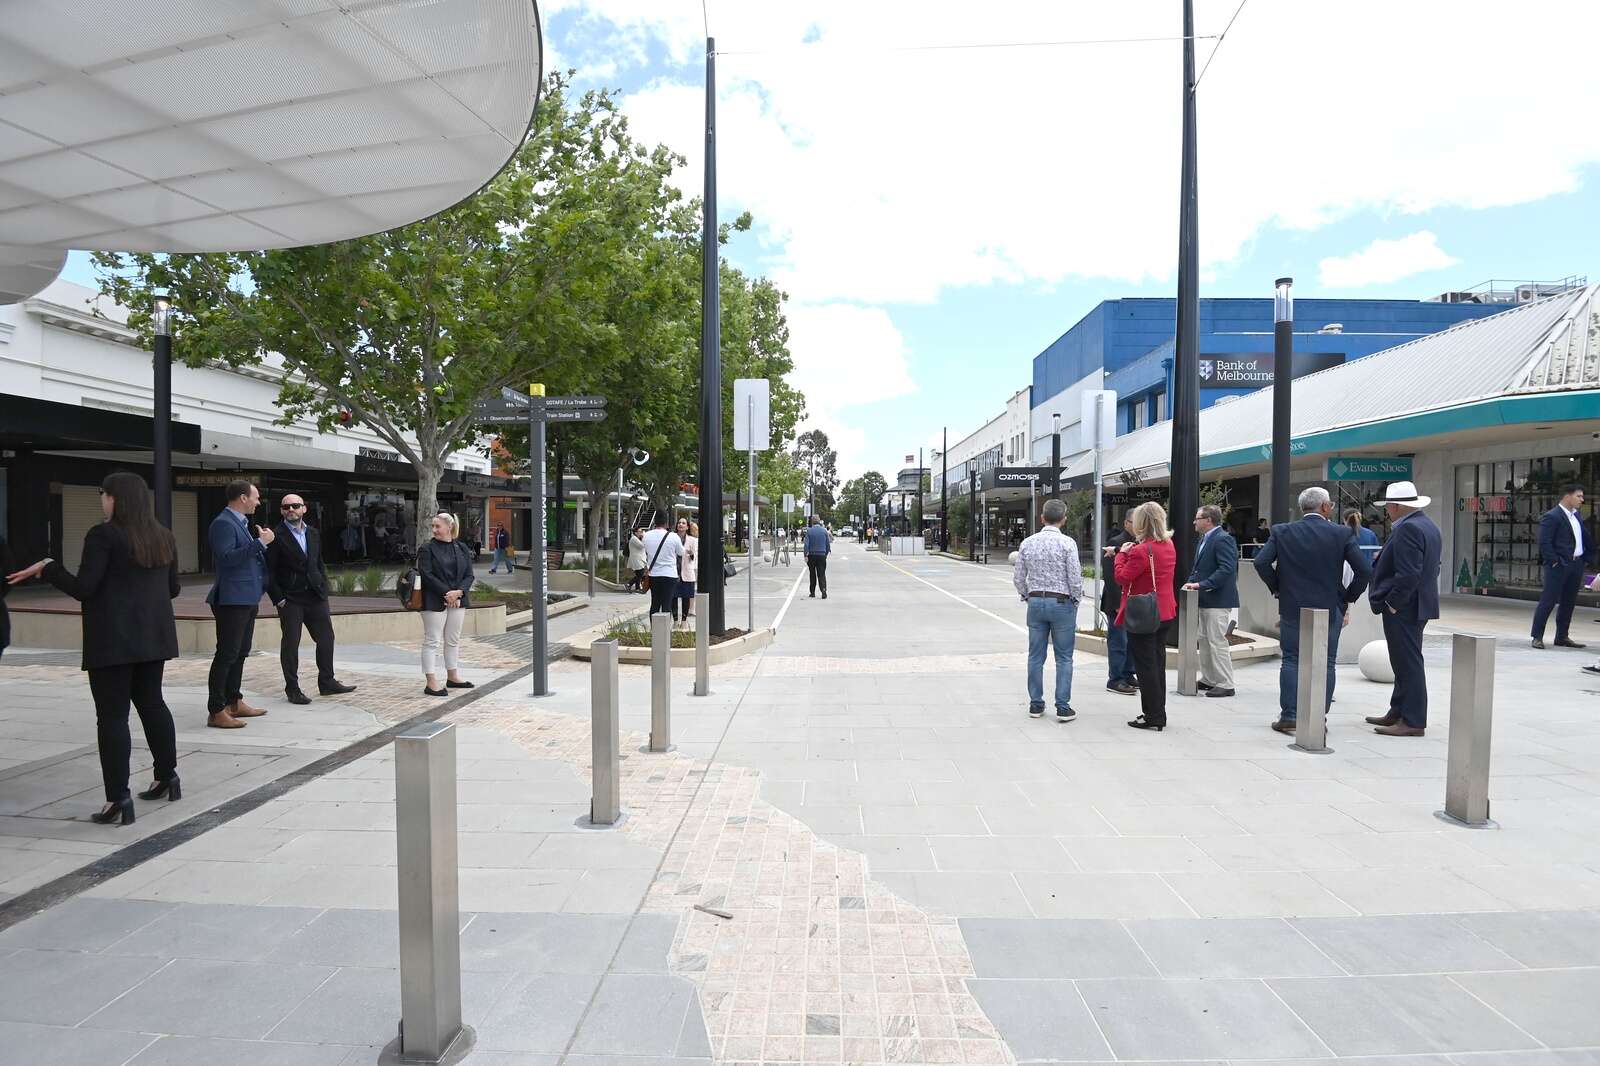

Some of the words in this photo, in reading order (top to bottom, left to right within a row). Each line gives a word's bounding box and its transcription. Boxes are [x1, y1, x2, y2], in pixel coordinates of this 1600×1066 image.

[1216, 360, 1244, 370] Bank
[1246, 360, 1257, 370] of
[1216, 371, 1274, 381] Melbourne
[1350, 462, 1378, 473] Evans
[1380, 462, 1408, 473] Shoes
